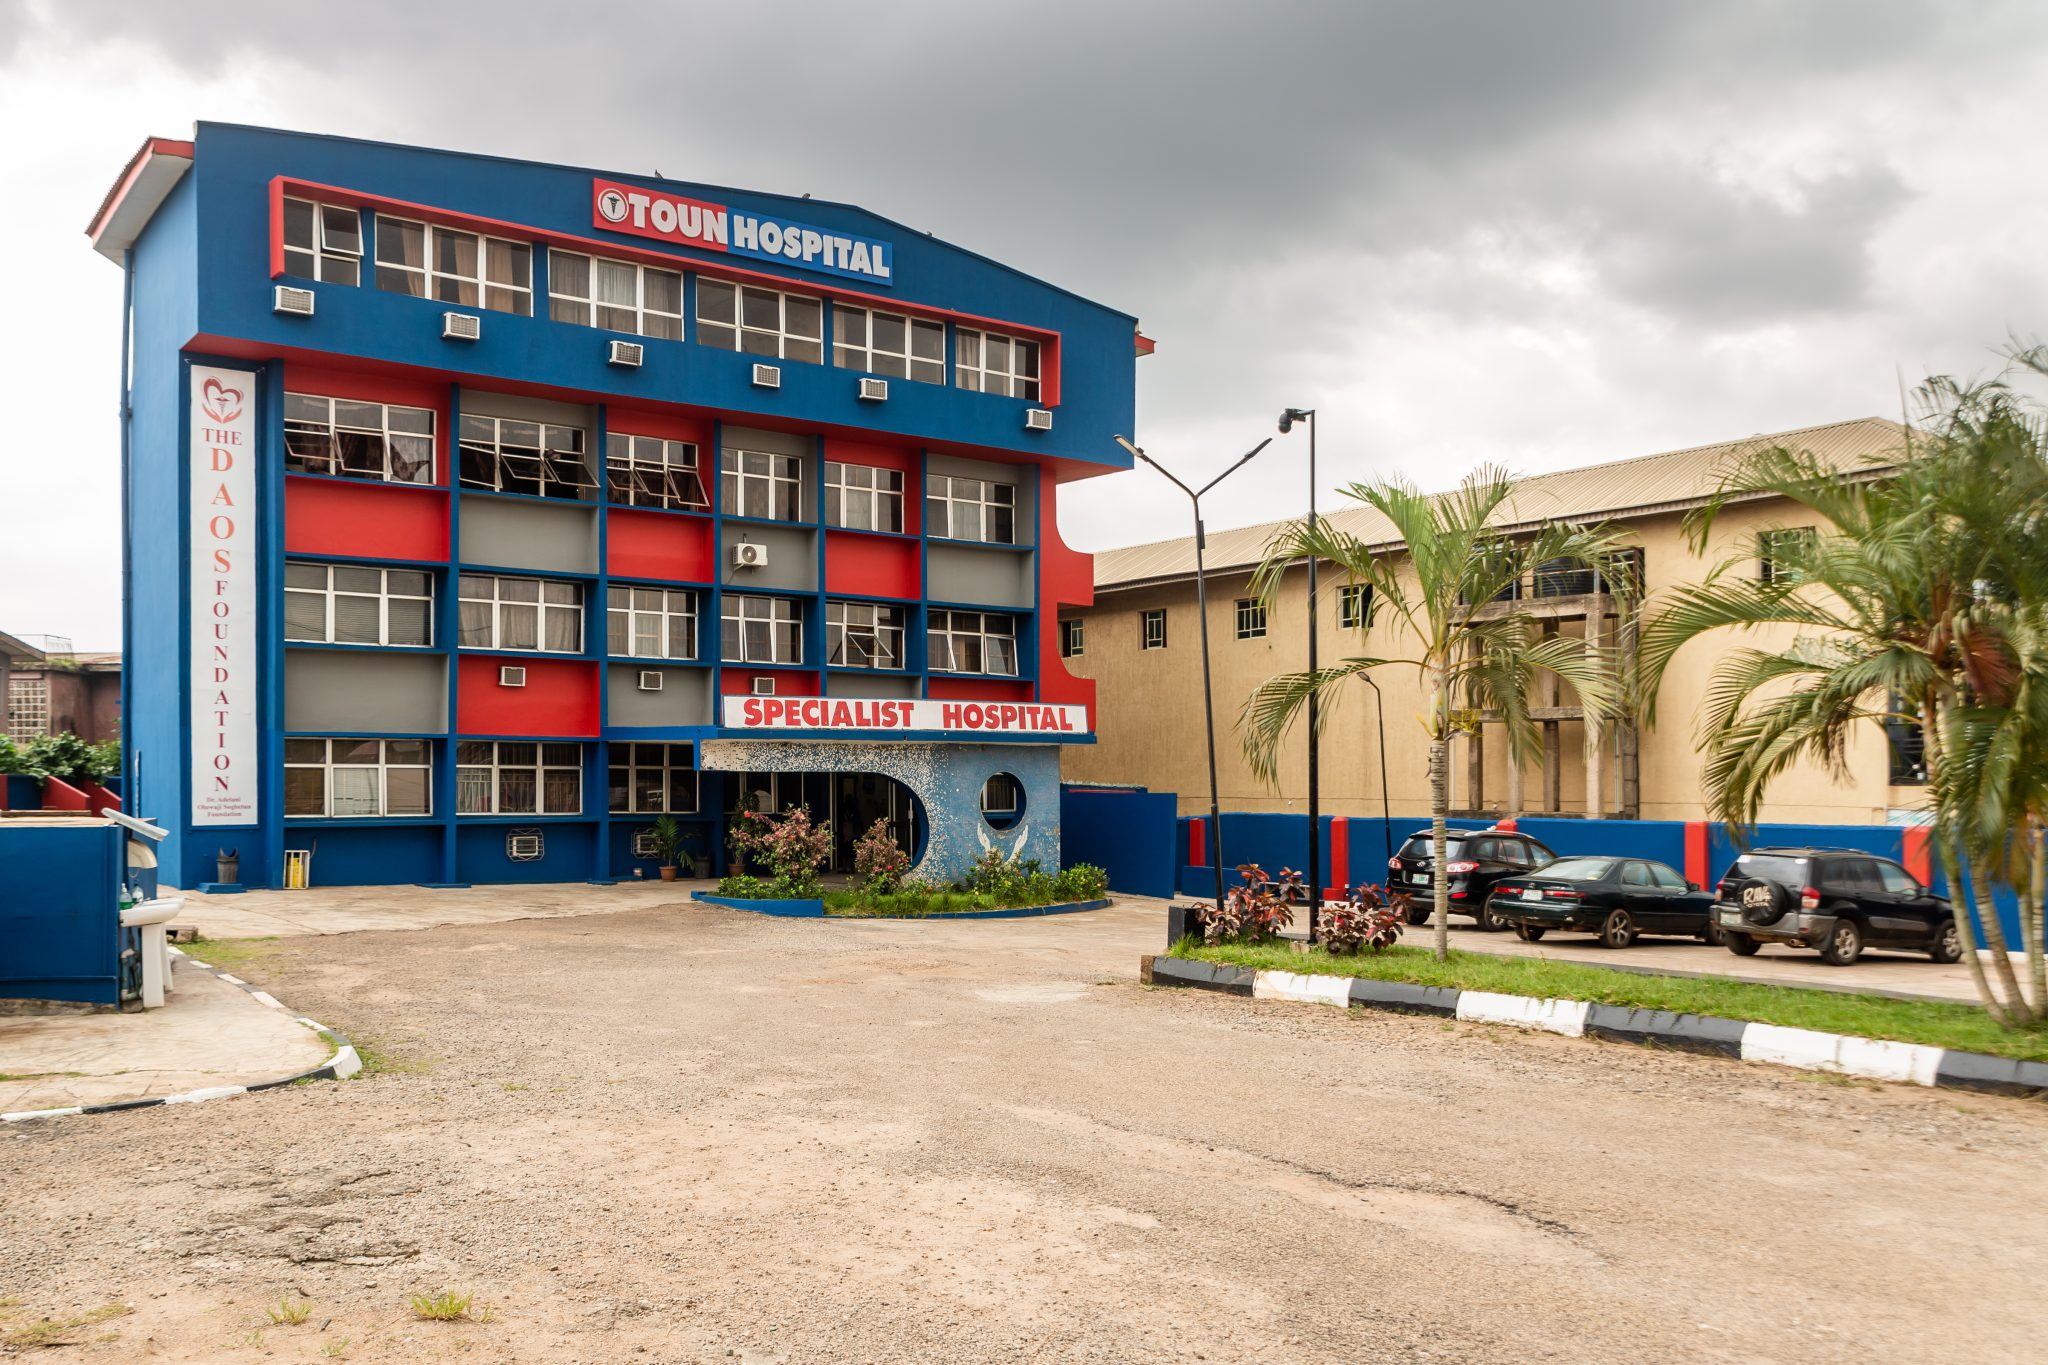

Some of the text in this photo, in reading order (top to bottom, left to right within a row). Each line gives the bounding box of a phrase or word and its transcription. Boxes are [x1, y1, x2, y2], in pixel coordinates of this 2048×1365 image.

[628, 193, 890, 278] TOUN HOSPITAL
[201, 427, 242, 446] THE
[209, 447, 235, 574] DAOS
[213, 580, 230, 792] FOUNDATION
[743, 698, 1073, 731] SPECIALIST HOSPITAL
